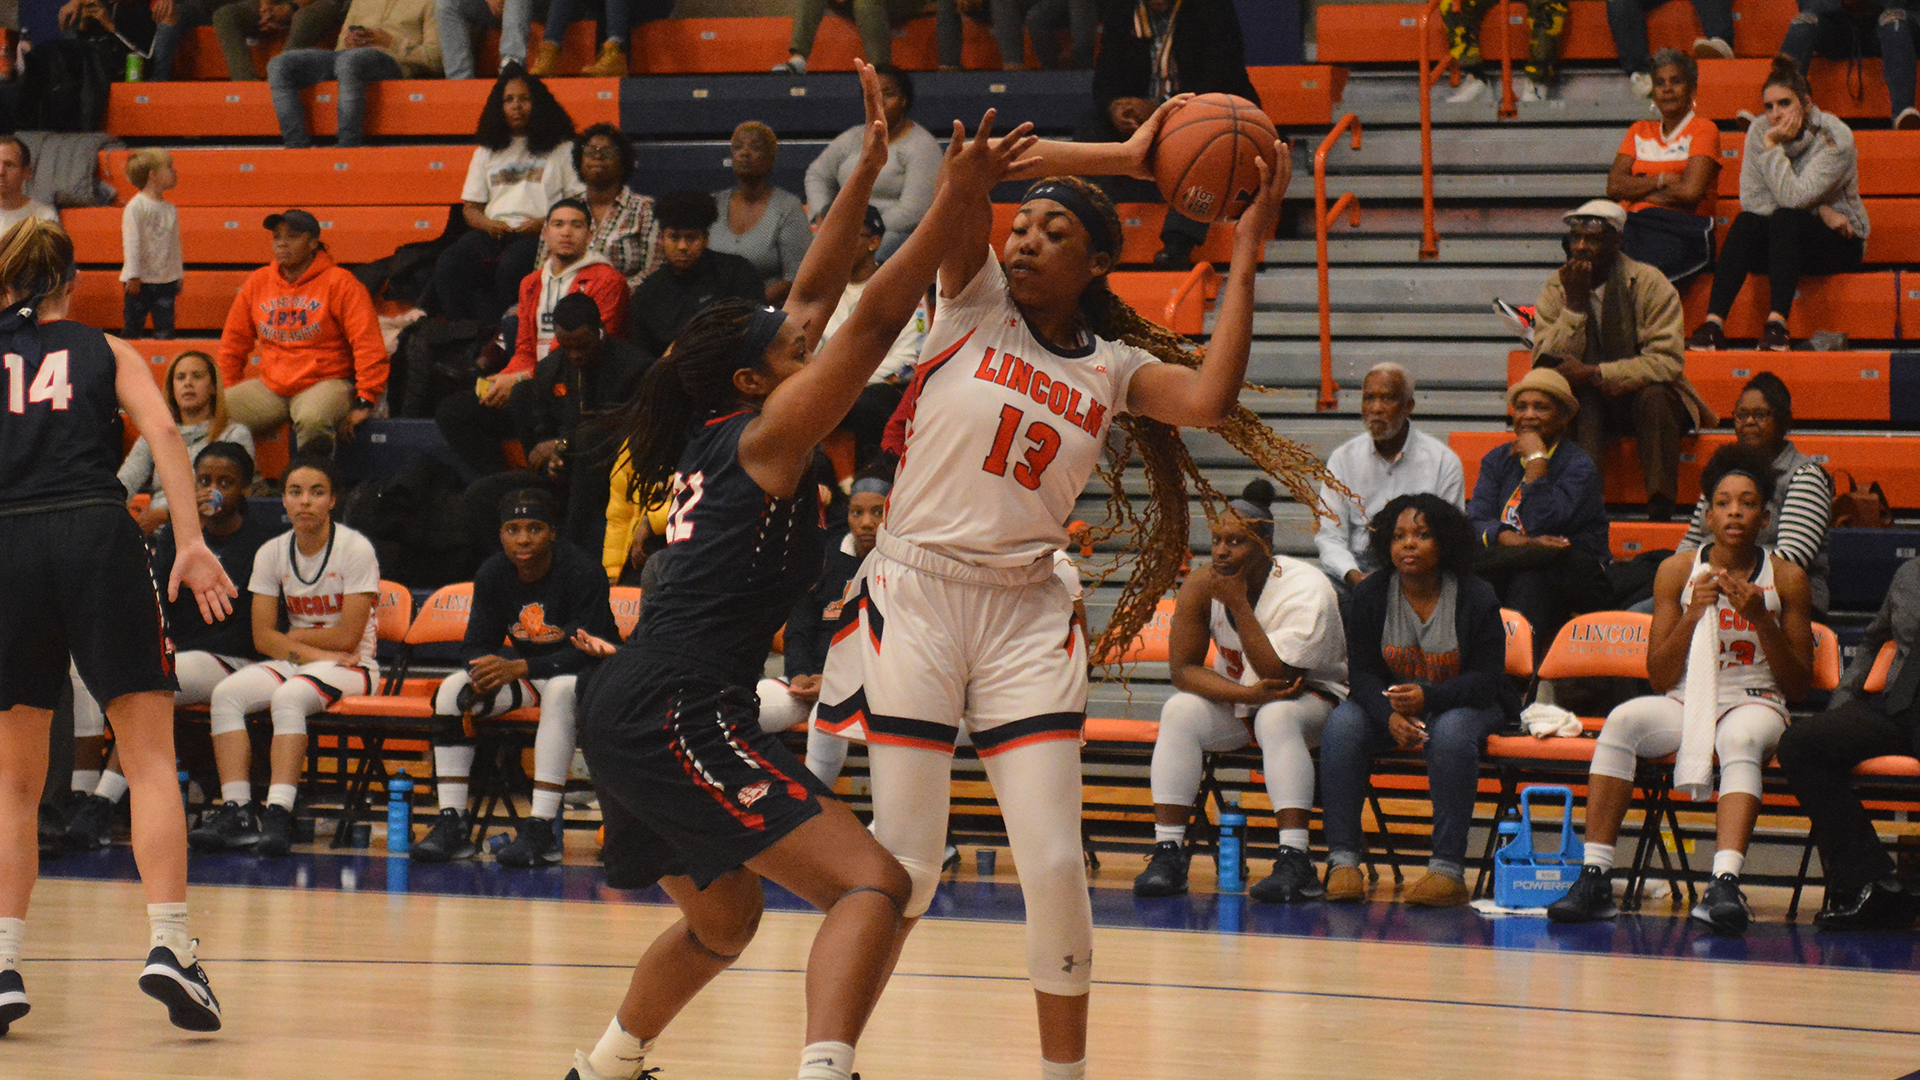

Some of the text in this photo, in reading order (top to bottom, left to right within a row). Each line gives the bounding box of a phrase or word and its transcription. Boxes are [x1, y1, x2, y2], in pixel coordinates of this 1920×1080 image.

[260, 296, 322, 312] LINCOLN
[2, 349, 74, 415] 14
[974, 346, 1107, 439] LINCOLN
[982, 403, 1062, 491] 13
[1569, 623, 1649, 644] LINCOL
